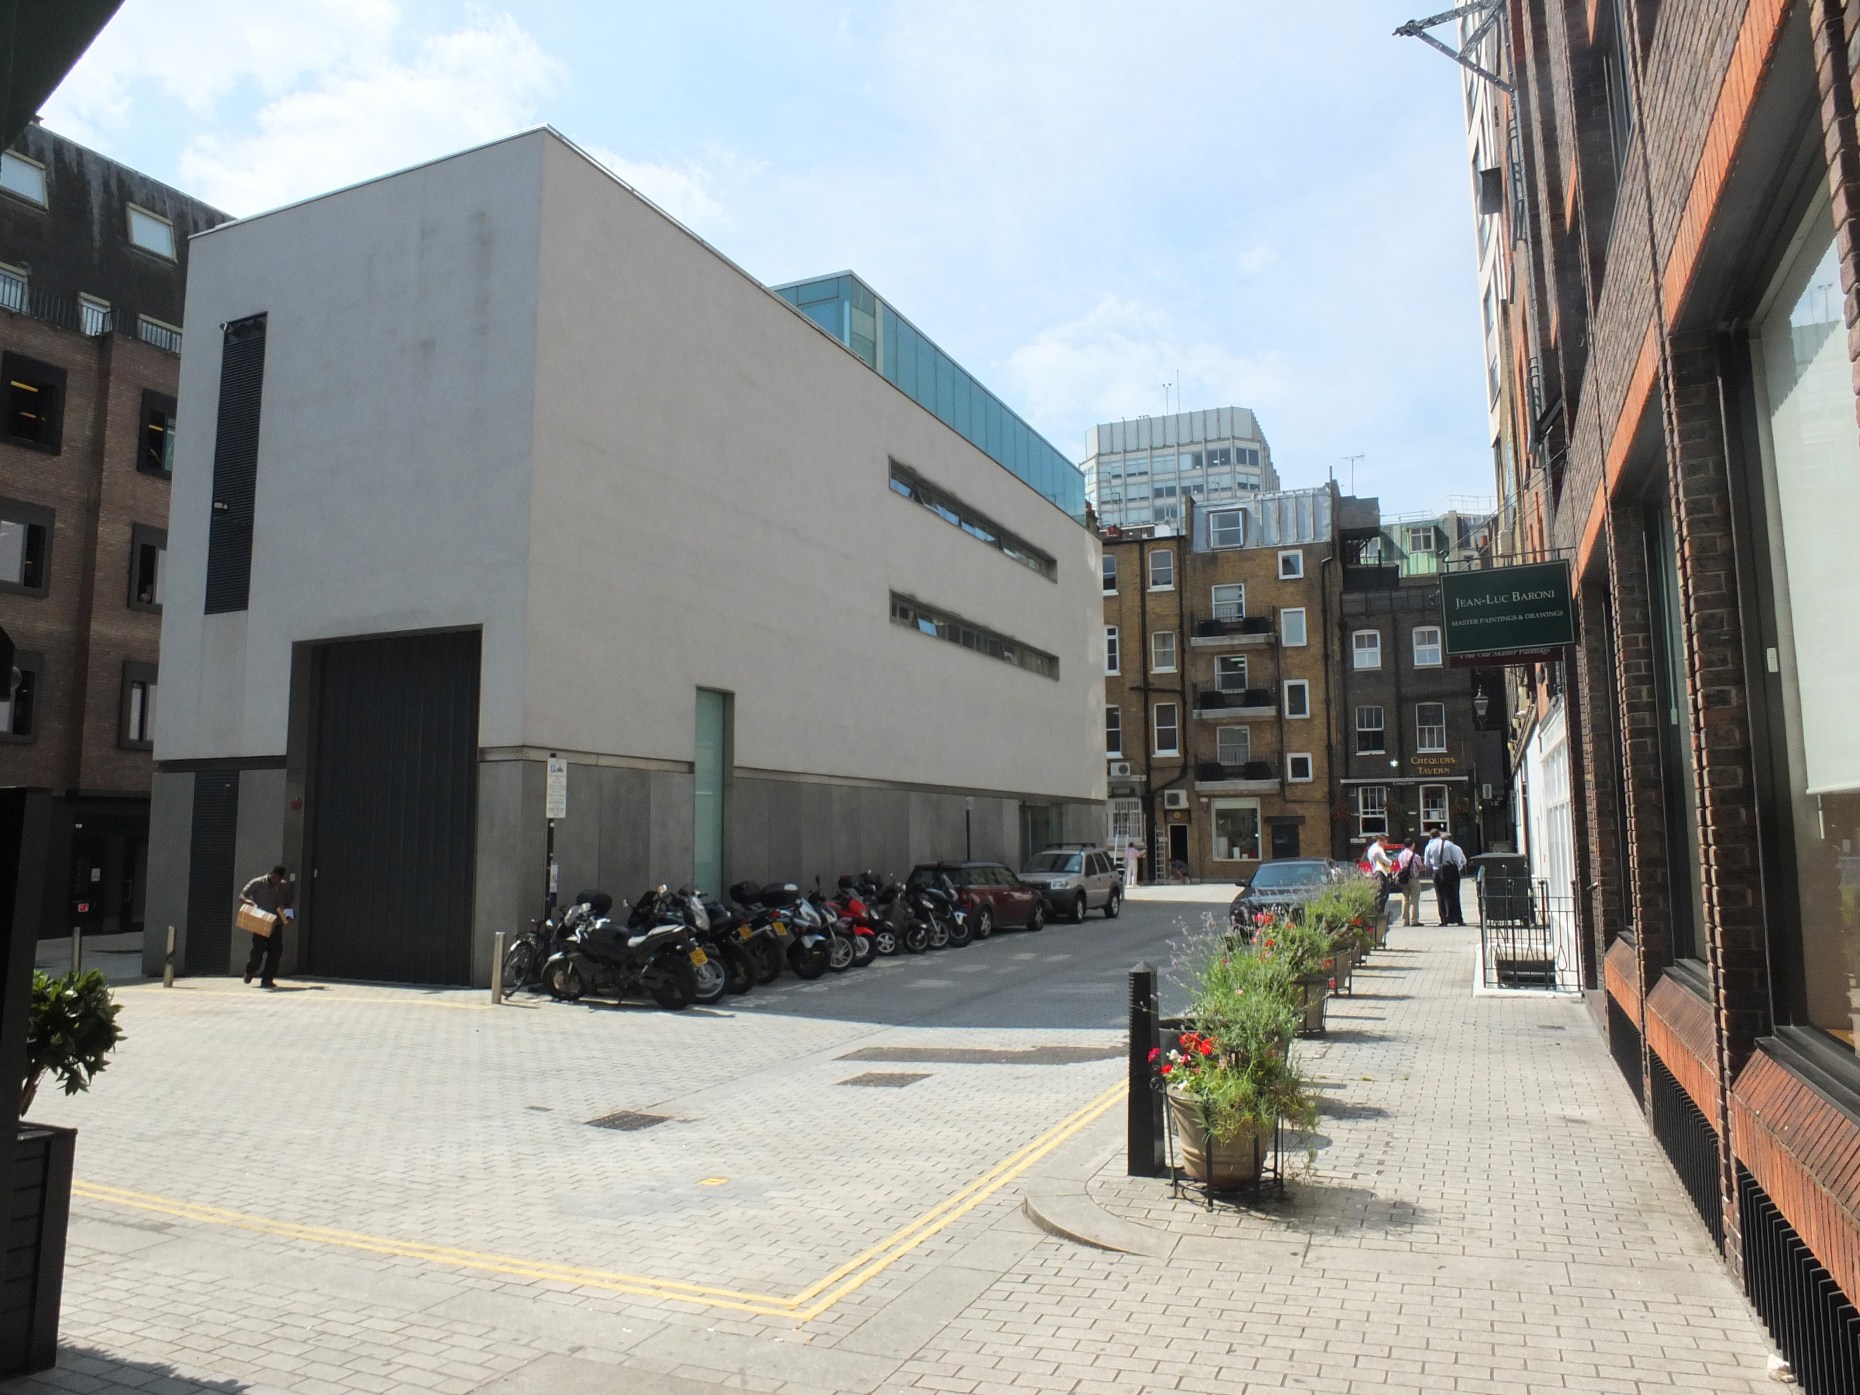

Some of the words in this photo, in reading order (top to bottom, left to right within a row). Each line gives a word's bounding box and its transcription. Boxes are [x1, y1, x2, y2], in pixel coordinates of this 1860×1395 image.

[1512, 590, 1555, 602] BARONI
[1451, 618, 1478, 626] MASTER
[1480, 615, 1517, 624] PAINTINGS
[1525, 610, 1564, 619] DRAWINGS
